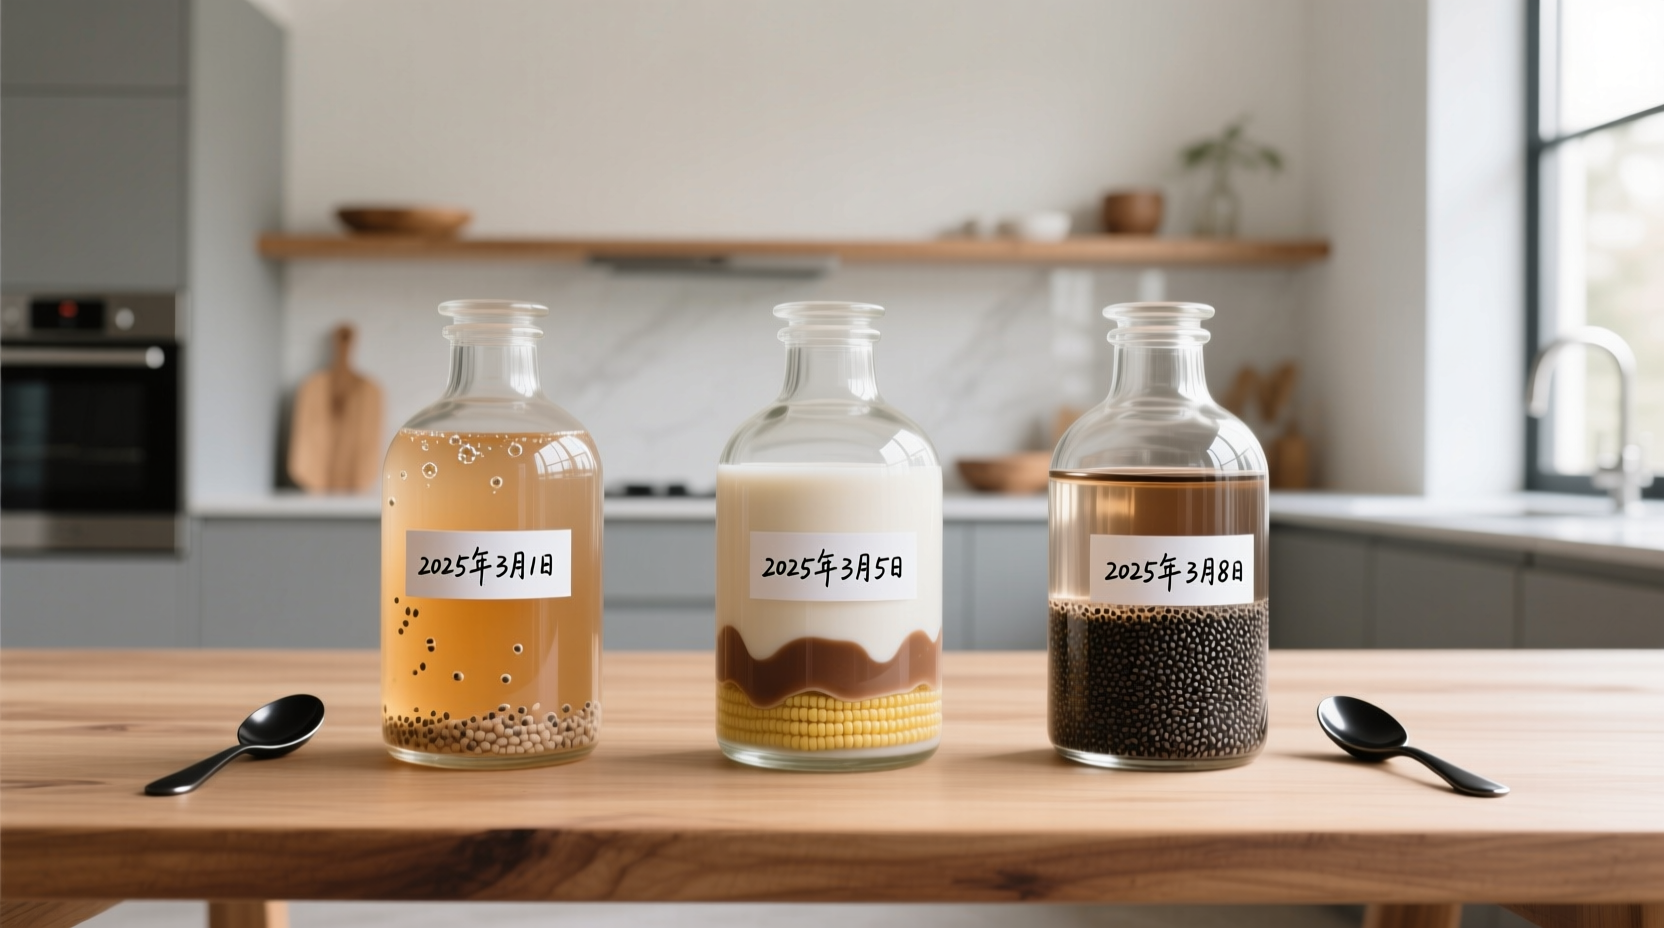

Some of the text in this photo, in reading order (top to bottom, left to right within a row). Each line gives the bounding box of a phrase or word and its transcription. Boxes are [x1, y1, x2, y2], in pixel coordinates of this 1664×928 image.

[417, 546, 554, 587] 2025年3月1日
[761, 548, 902, 588] 2025年3月5日
[1104, 552, 1244, 593] 2025年3月8日
